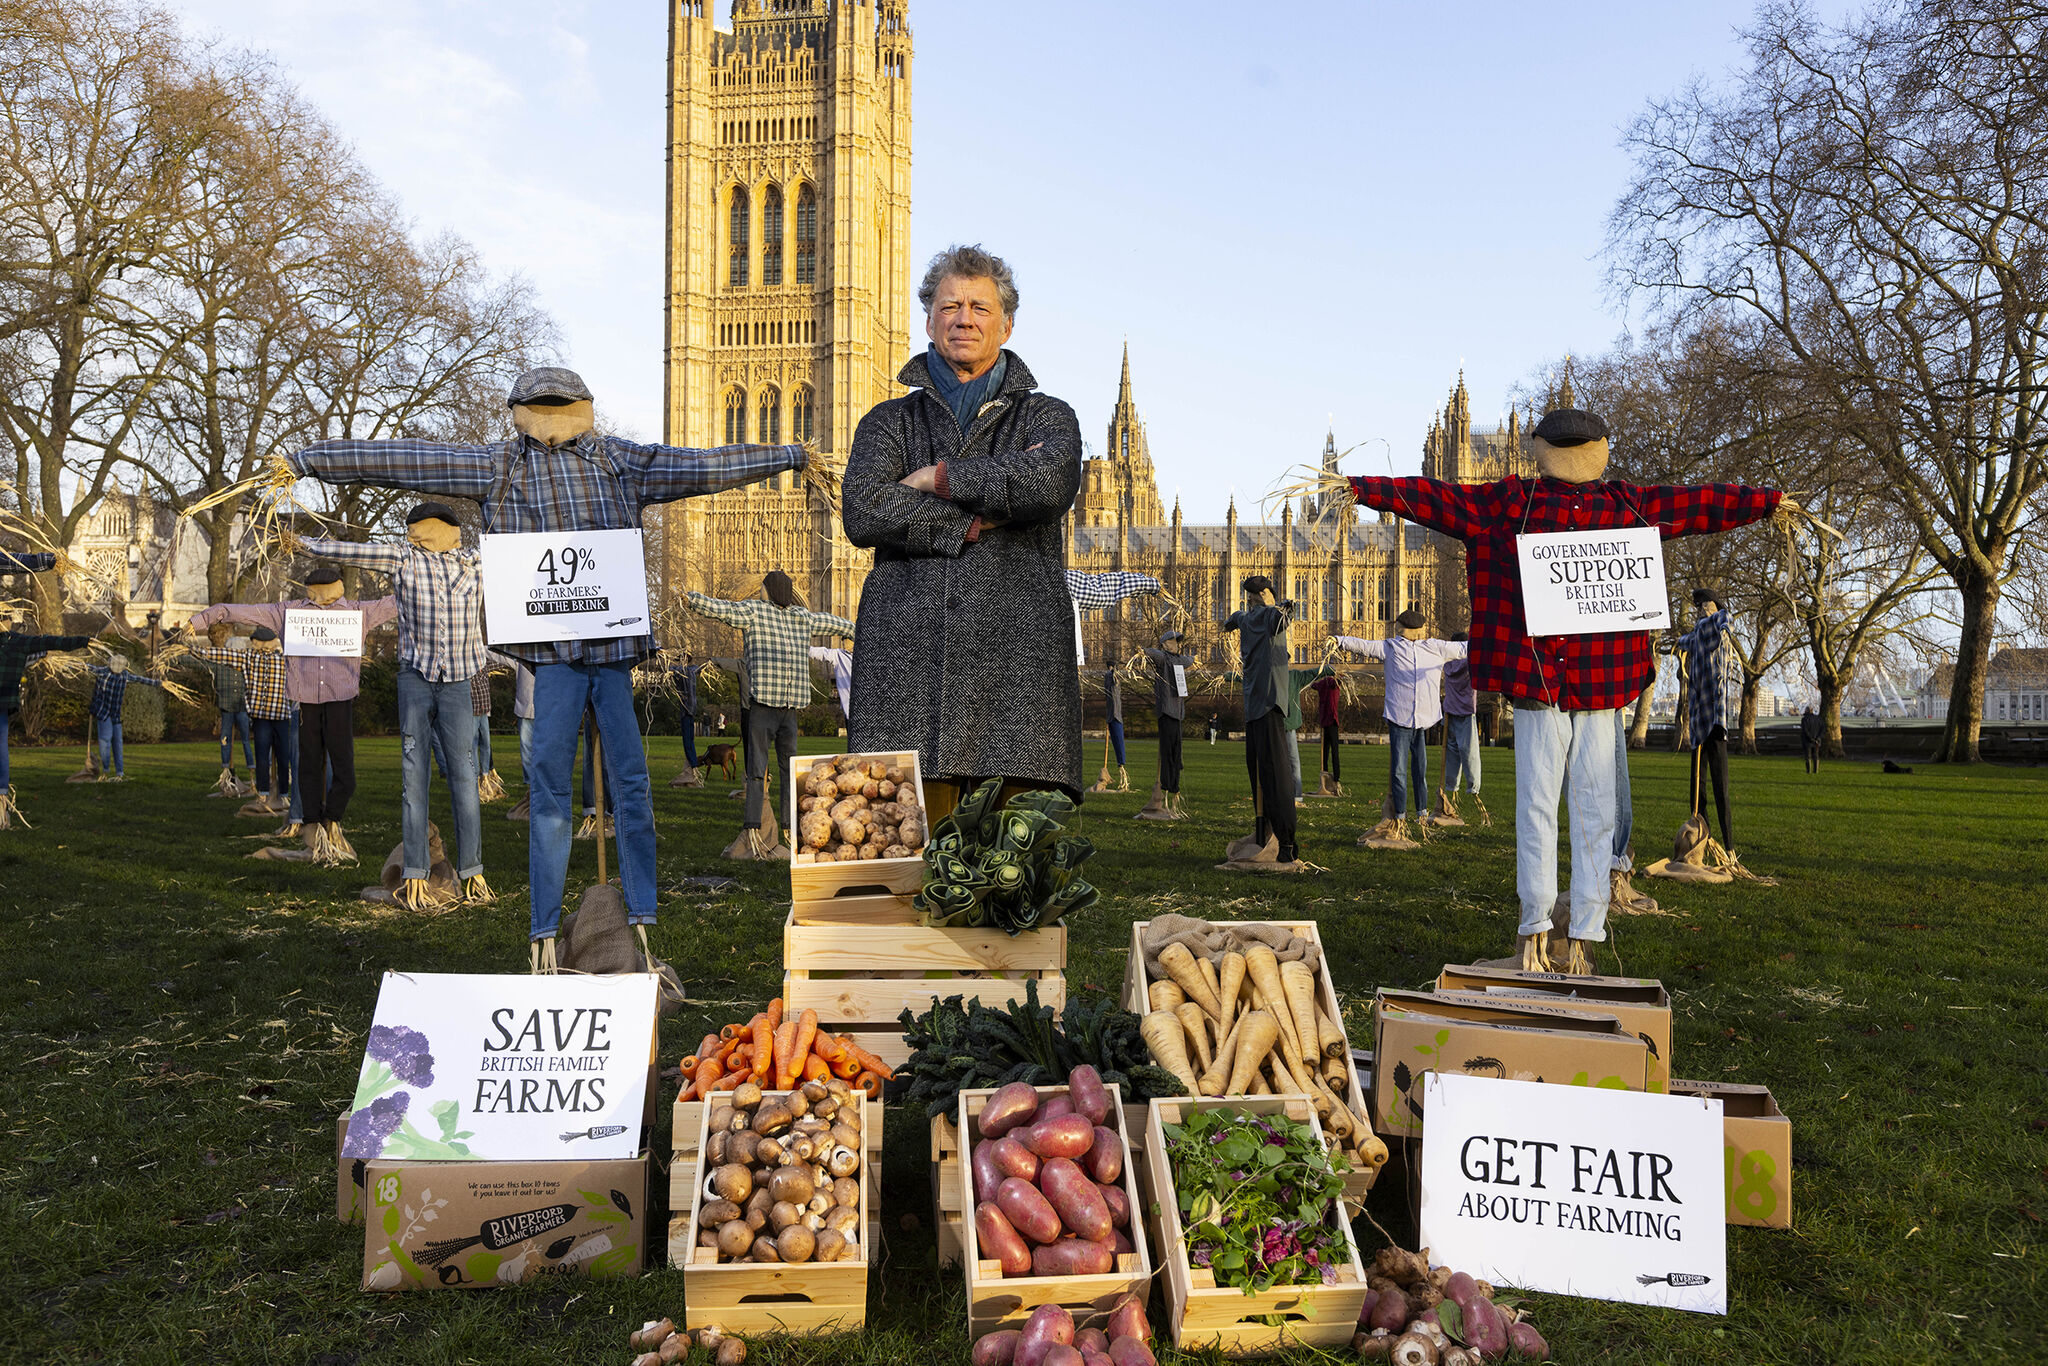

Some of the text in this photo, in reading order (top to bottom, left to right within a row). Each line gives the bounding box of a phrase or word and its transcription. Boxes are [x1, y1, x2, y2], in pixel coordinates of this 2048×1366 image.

[537, 547, 595, 585] 49%
[1549, 557, 1654, 584] SUPPORT
[529, 588, 544, 599] OF
[1566, 583, 1624, 600] BRITISH
[528, 598, 606, 614] ON THE BRINK
[1577, 598, 1637, 614] FARMERS
[302, 626, 328, 638] FAIR
[315, 638, 355, 646] FARMERS
[484, 1008, 612, 1052] SAVE
[480, 1056, 609, 1072] BRITISH FAMILY
[472, 1078, 605, 1113] FARMS
[1460, 1136, 1683, 1205] GET FAIR
[377, 1177, 398, 1202] 18
[480, 1190, 492, 1199] you
[495, 1189, 511, 1197] leave
[520, 1188, 532, 1196] out
[507, 1181, 520, 1189] this
[490, 1207, 564, 1241] RIVERFORD
[1457, 1192, 1682, 1241] ABOUT FARMING
[494, 1214, 566, 1247] ORGANIC FARMERS
